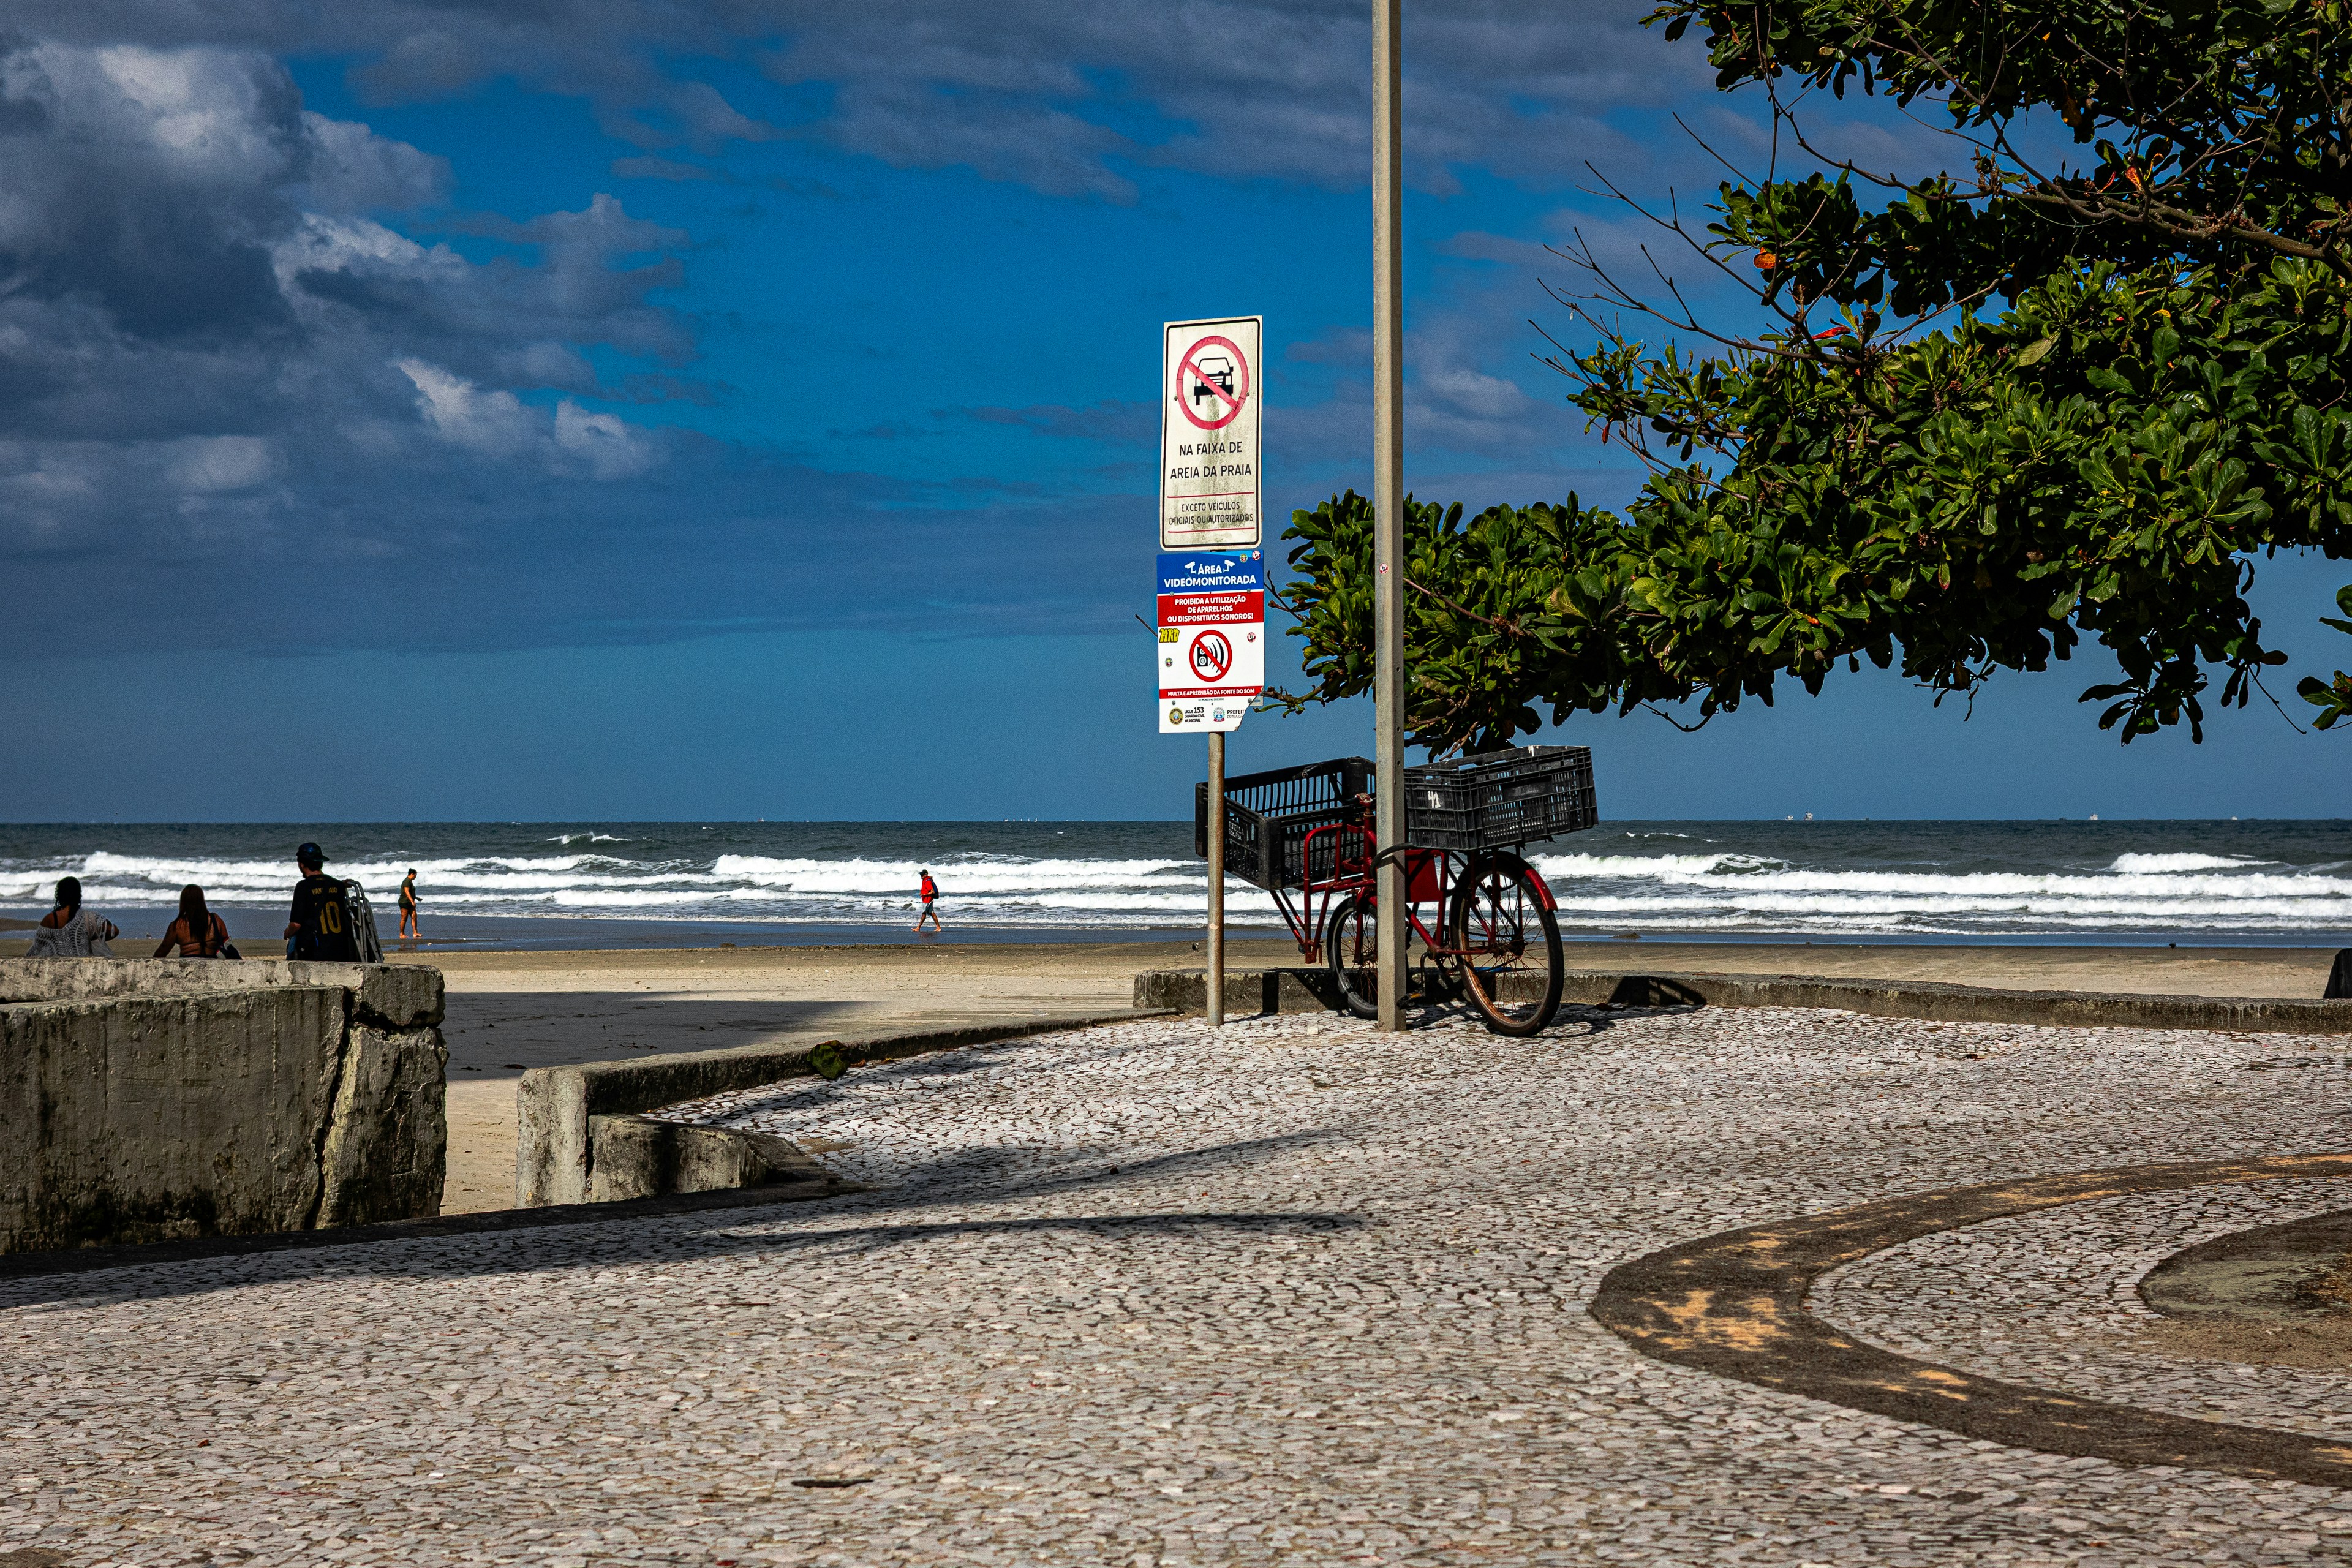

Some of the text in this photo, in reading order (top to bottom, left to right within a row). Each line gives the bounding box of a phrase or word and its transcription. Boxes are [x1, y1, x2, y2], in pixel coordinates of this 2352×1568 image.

[1180, 441, 1242, 456] NA FAIXA DE
[1170, 464, 1251, 479] AREIA DA PRAIA
[1182, 503, 1206, 512] EXCETO
[1169, 513, 1253, 525] OFICIAIS OU AUTORIZADOS
[1197, 564, 1222, 575] ÁREA
[1164, 575, 1256, 587] VIDEOMONITORADA
[1210, 594, 1246, 605] UTILIZAÇÃO
[1178, 614, 1220, 622] DISPOSITIVOS
[1428, 790, 1441, 809] 41
[315, 901, 342, 934] 10
